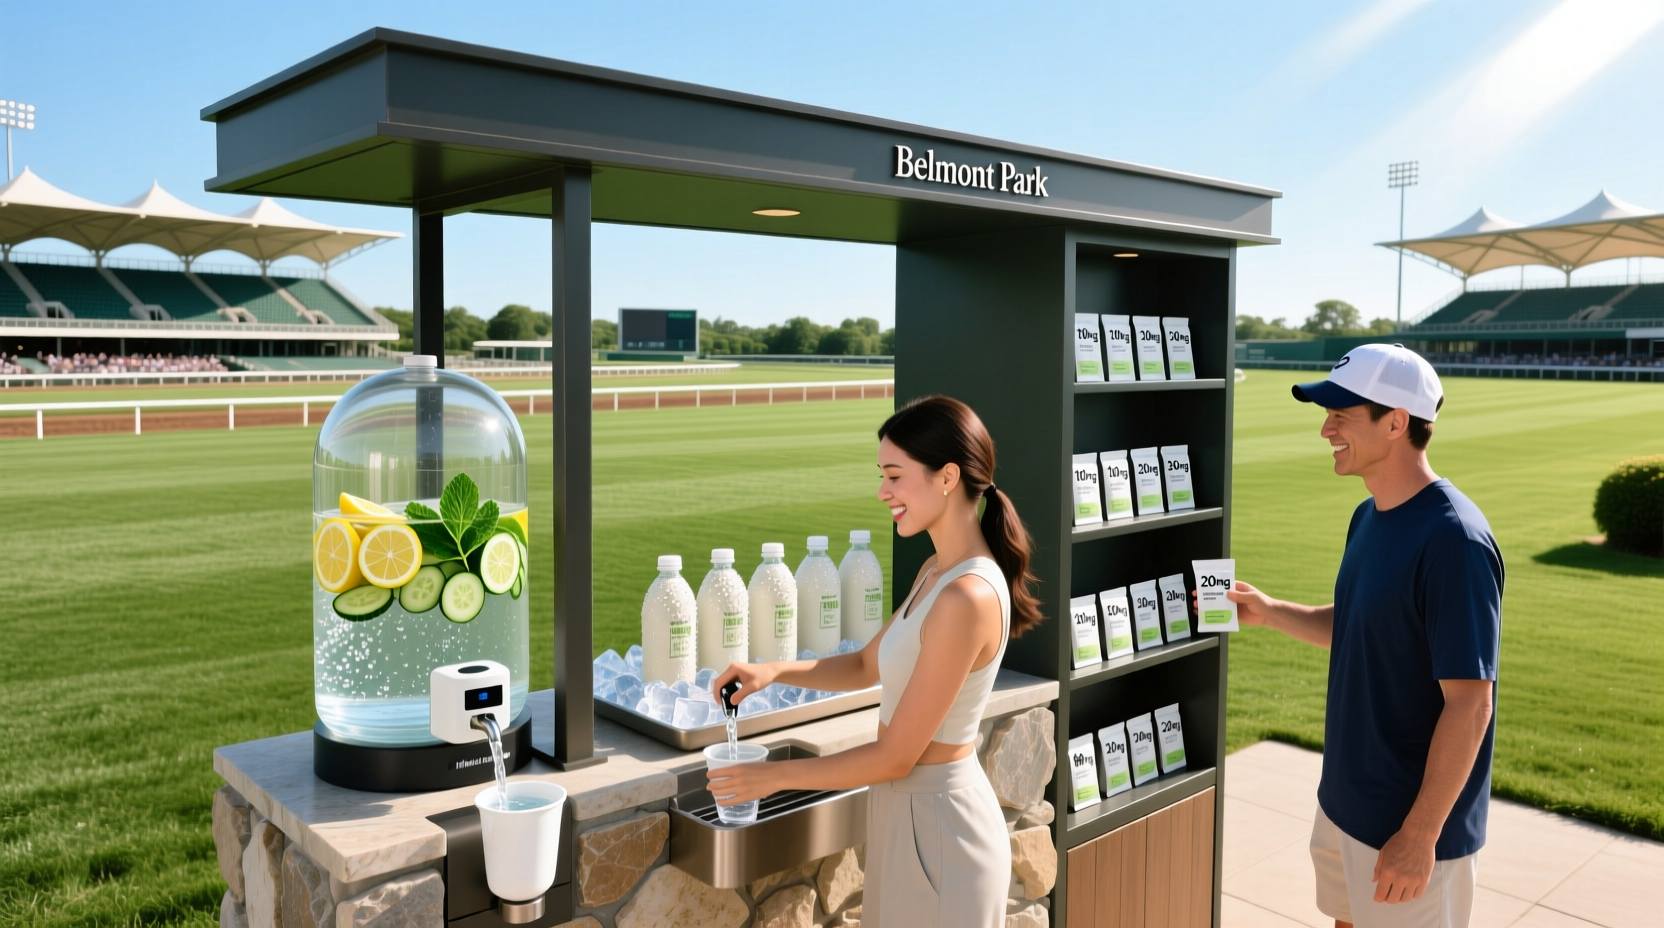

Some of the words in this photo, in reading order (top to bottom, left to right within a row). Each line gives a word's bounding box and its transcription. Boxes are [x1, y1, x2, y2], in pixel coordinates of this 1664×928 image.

[895, 144, 995, 190] Belmont
[1000, 161, 1049, 197] Park
[1201, 575, 1231, 590] 20mg
